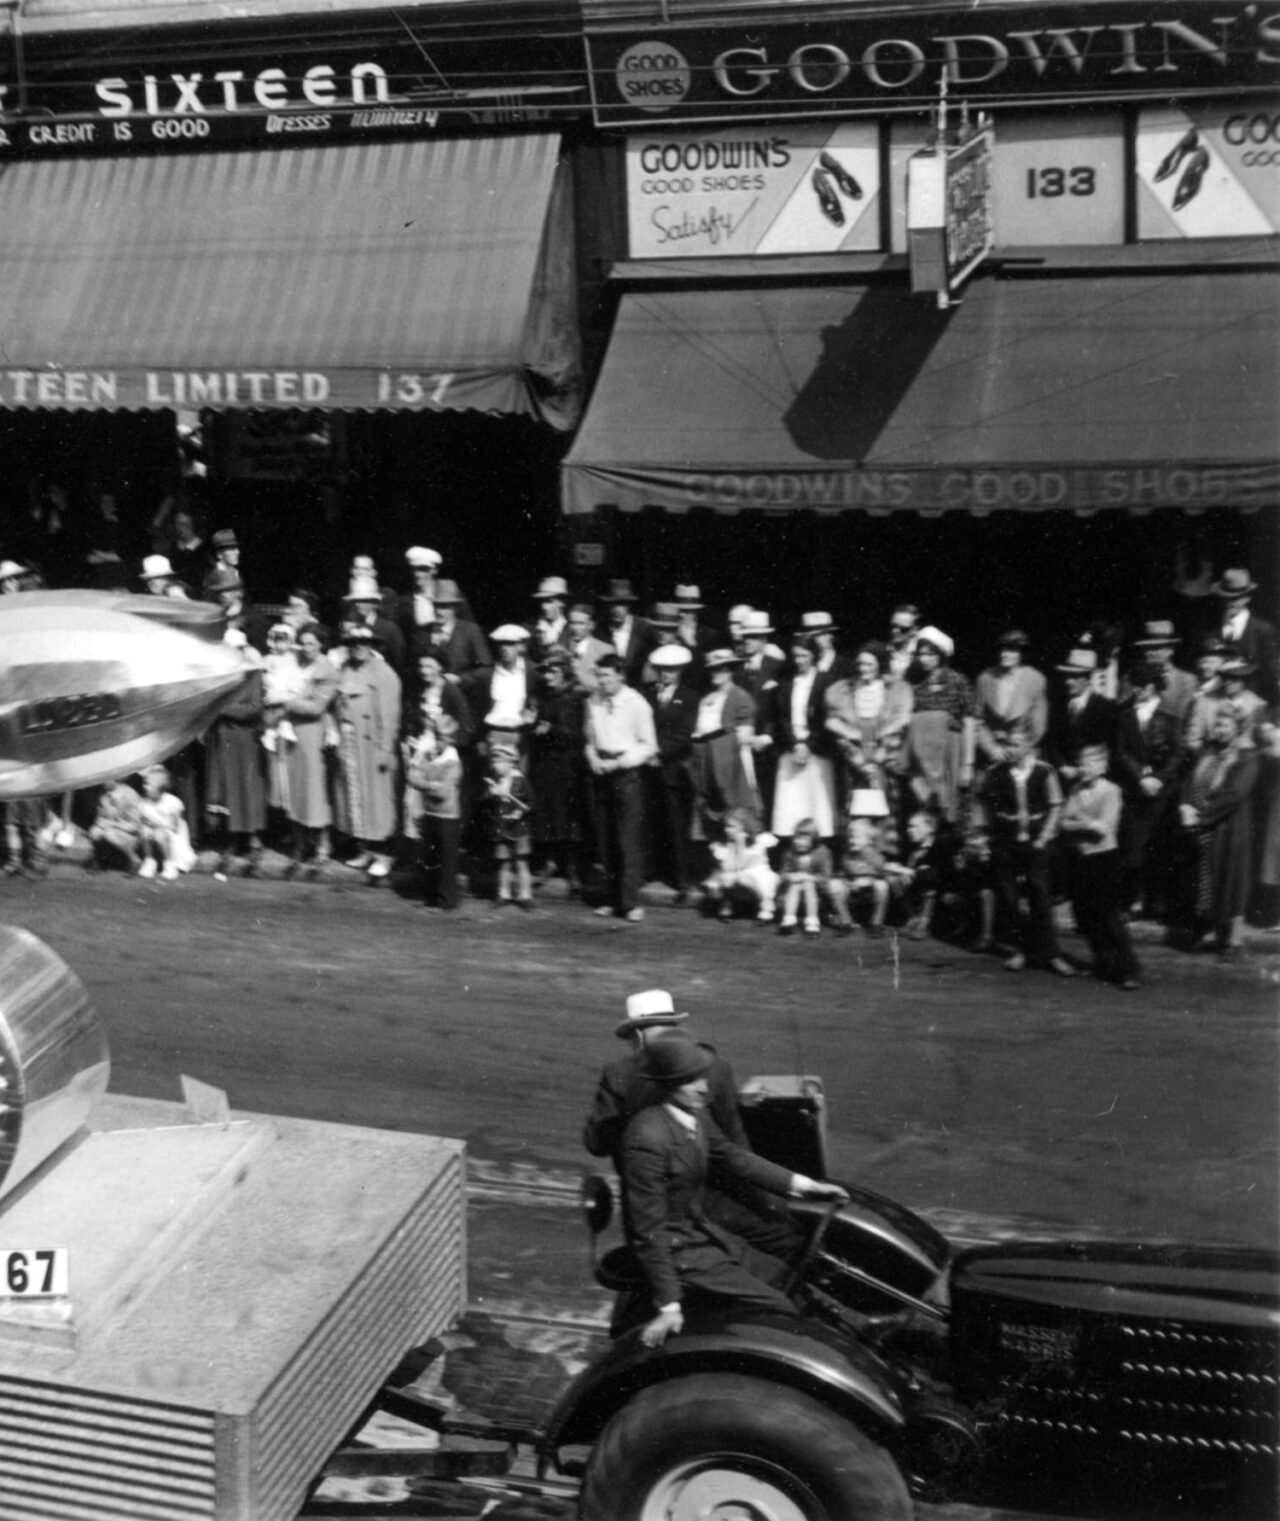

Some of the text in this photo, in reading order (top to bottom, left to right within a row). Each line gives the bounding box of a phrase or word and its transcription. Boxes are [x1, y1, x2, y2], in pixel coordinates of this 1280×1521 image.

[624, 54, 678, 71] GOOD
[713, 4, 1280, 96] GOODWIN'S
[626, 79, 684, 97] SHOES
[30, 123, 96, 143] CREDIT
[114, 120, 133, 141] IS
[152, 118, 210, 138] GOOD
[641, 137, 791, 173] GOODWIN'S
[641, 175, 766, 194] GOOD SHOES
[1026, 166, 1097, 199] 133
[651, 198, 758, 245] Satisfy
[145, 372, 330, 403] LIMITED
[378, 373, 456, 404] 137
[939, 471, 1068, 505] GOOD
[6, 1250, 56, 1293] 67
